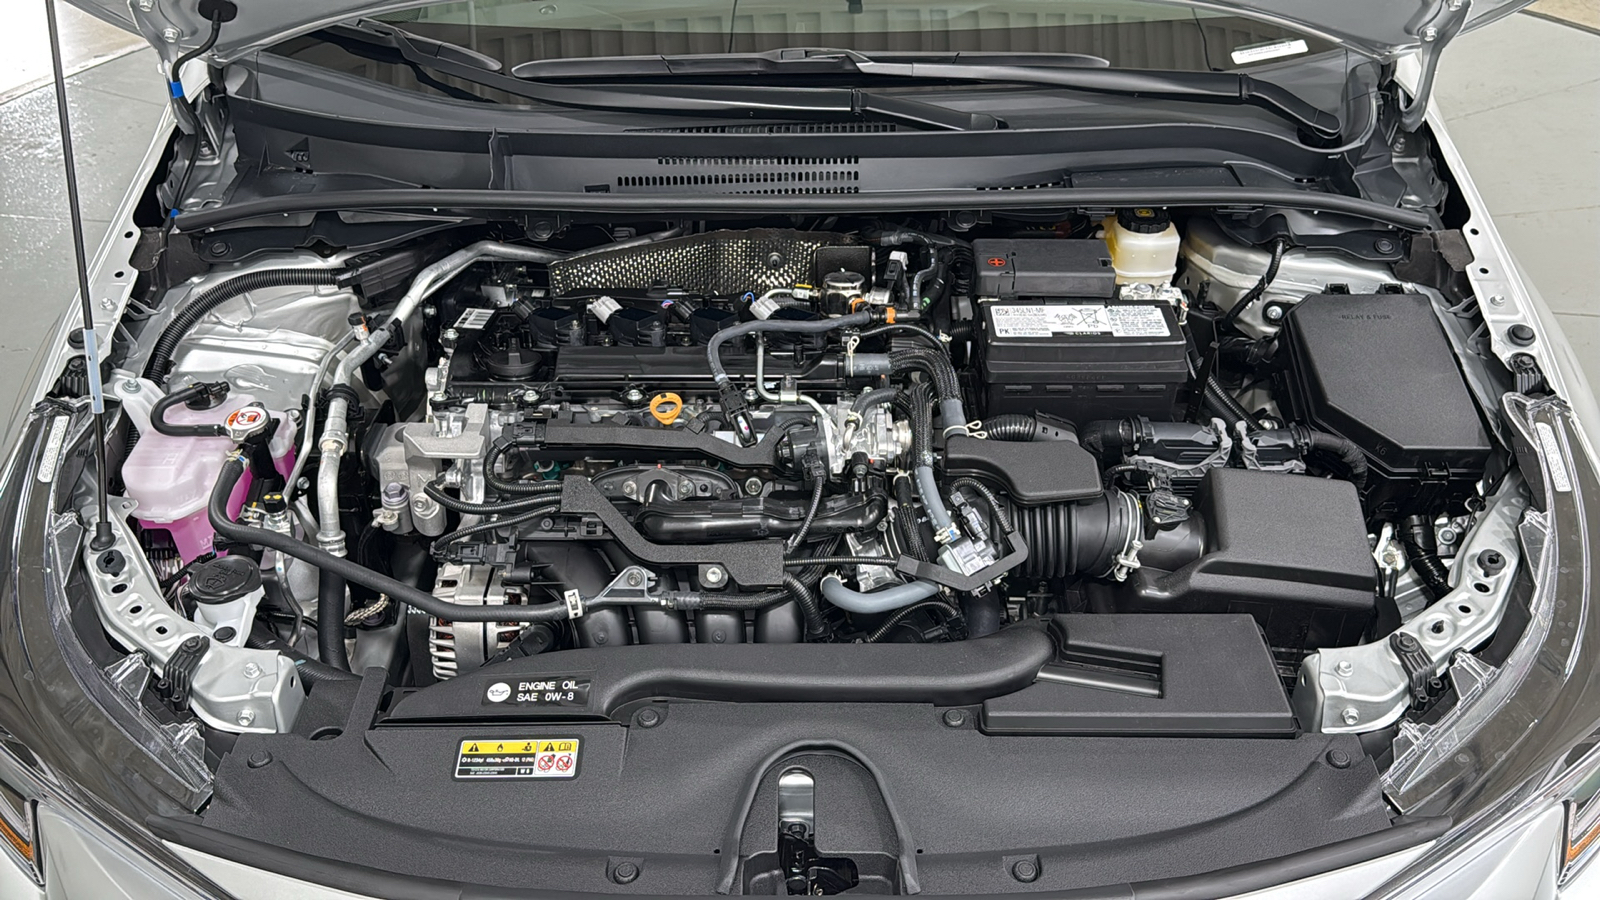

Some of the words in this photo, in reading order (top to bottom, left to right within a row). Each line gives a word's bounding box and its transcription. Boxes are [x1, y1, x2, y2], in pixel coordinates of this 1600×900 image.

[518, 681, 556, 691] ENGINE
[562, 680, 578, 690] OIL
[516, 692, 539, 702] SAE
[544, 691, 575, 702] 0W-8
